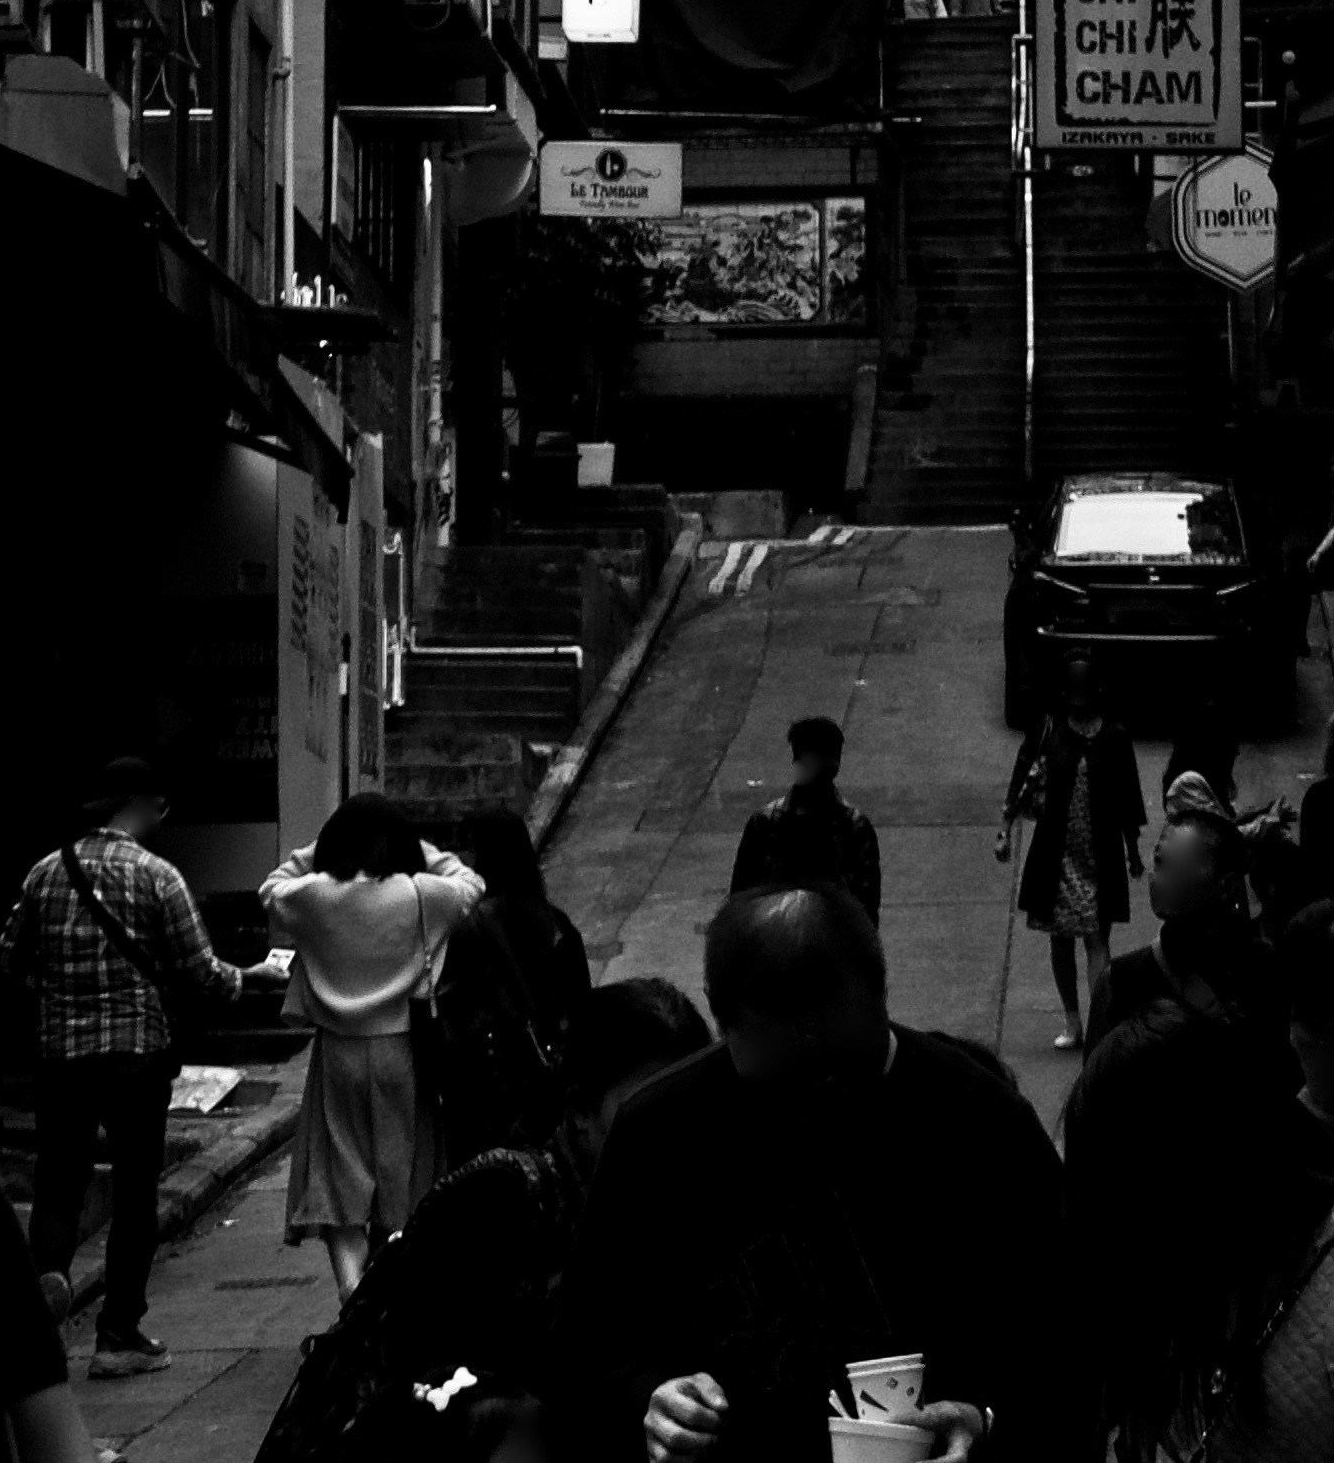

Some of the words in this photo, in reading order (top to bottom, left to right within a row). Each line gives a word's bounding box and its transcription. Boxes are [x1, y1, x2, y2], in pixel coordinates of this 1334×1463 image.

[1076, 20, 1137, 54] CHI
[1076, 71, 1202, 105] CHAM
[1062, 132, 1143, 145] IZAKAYA
[1167, 132, 1216, 145] SAKE
[1233, 182, 1251, 206] le
[1196, 208, 1277, 228] momen
